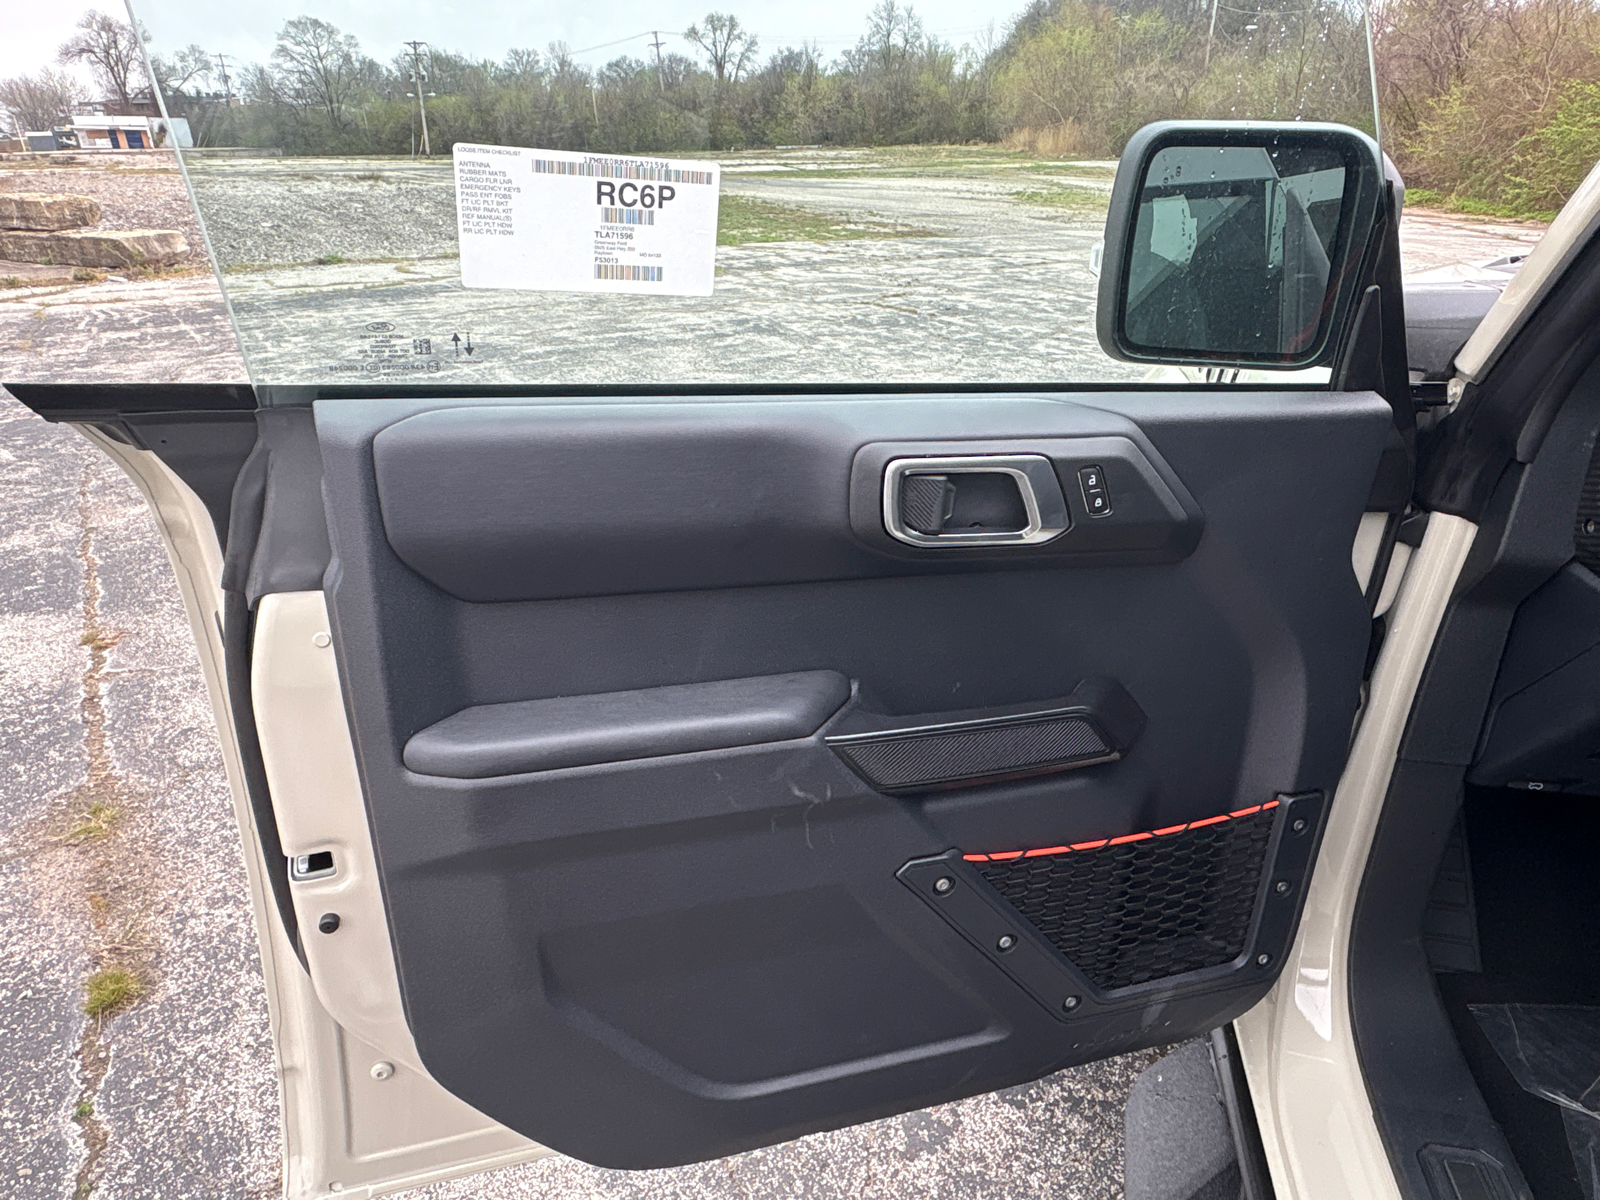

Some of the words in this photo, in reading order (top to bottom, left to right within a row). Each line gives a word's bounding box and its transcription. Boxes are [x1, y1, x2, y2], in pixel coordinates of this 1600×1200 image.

[458, 160, 491, 168] ANTENNA
[459, 168, 487, 176] RUBBER
[460, 183, 502, 191] EMERGENCY
[596, 181, 676, 209] RC6P
[476, 214, 512, 222] MANUAL(S)
[594, 231, 634, 240] TLA71596
